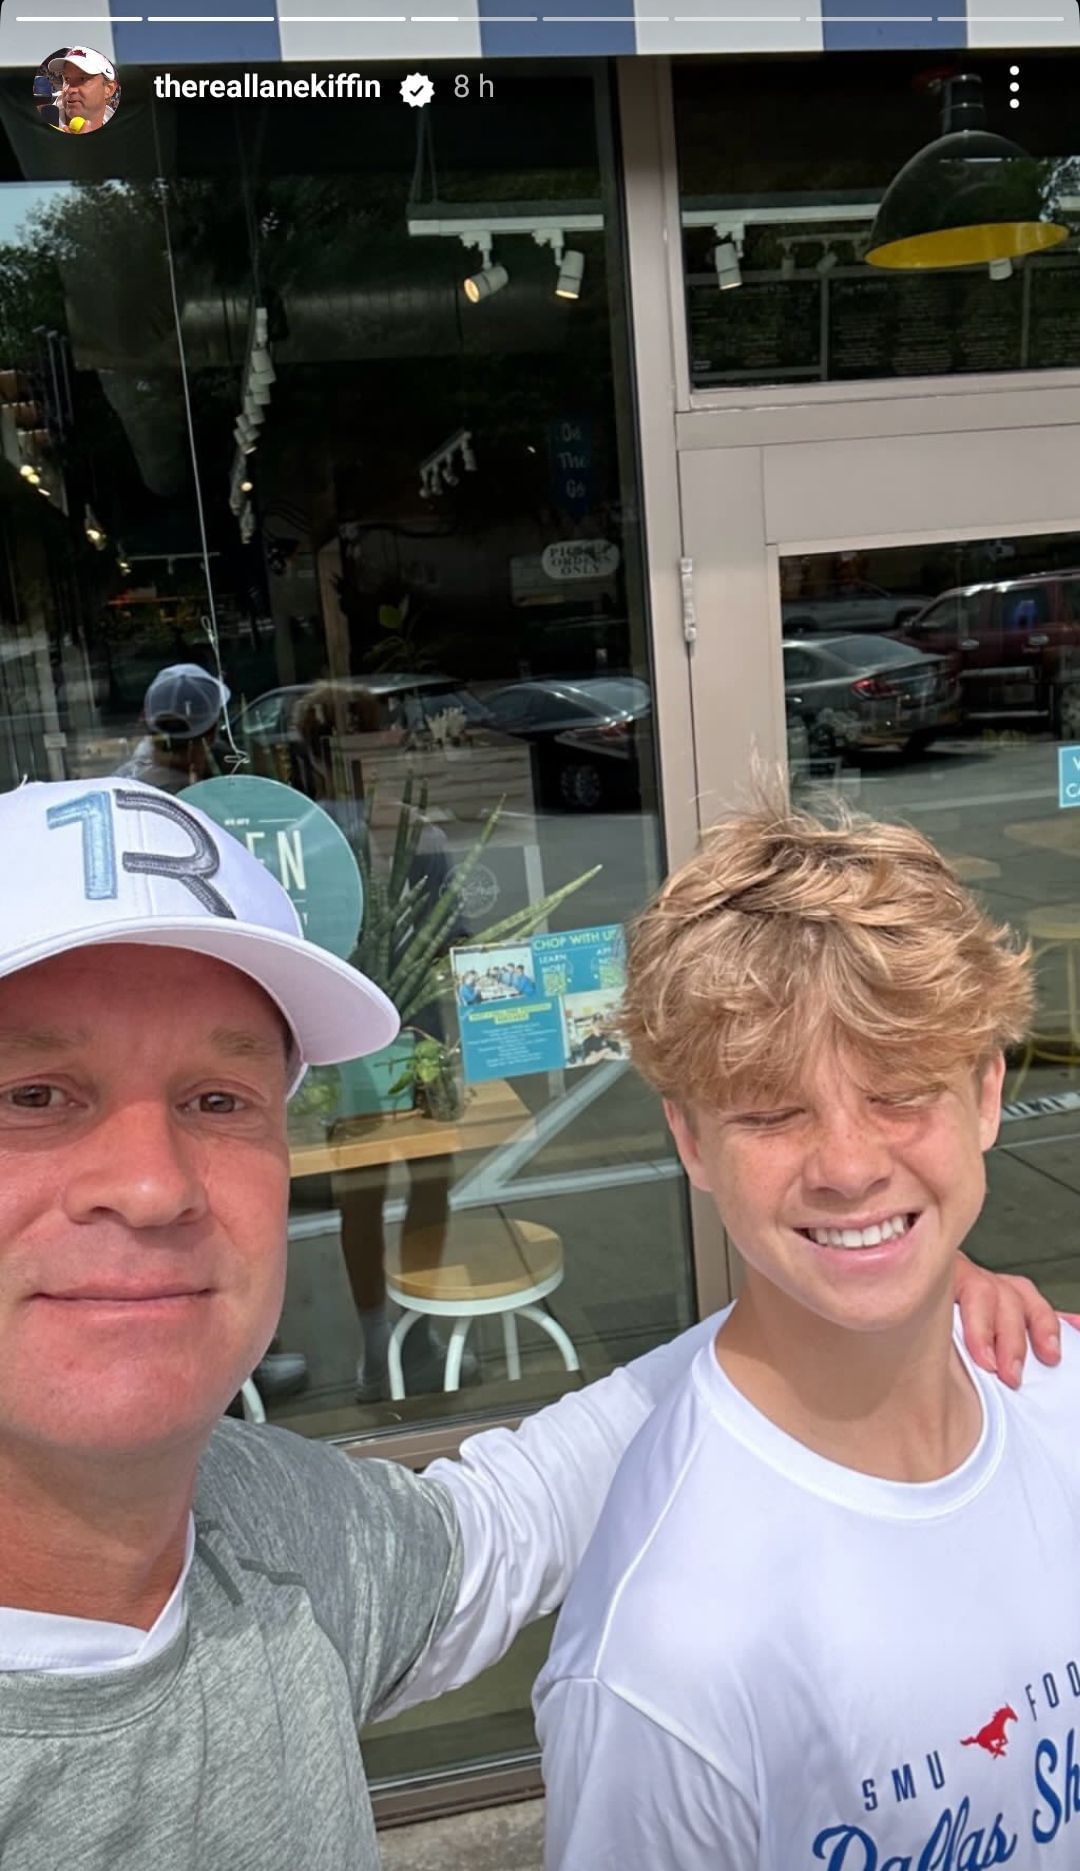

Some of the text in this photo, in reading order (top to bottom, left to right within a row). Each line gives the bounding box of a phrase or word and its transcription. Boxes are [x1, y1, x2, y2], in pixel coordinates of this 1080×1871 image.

[534, 937, 567, 952] CHOP
[569, 930, 599, 945] WITH
[861, 1750, 945, 1811] SMU
